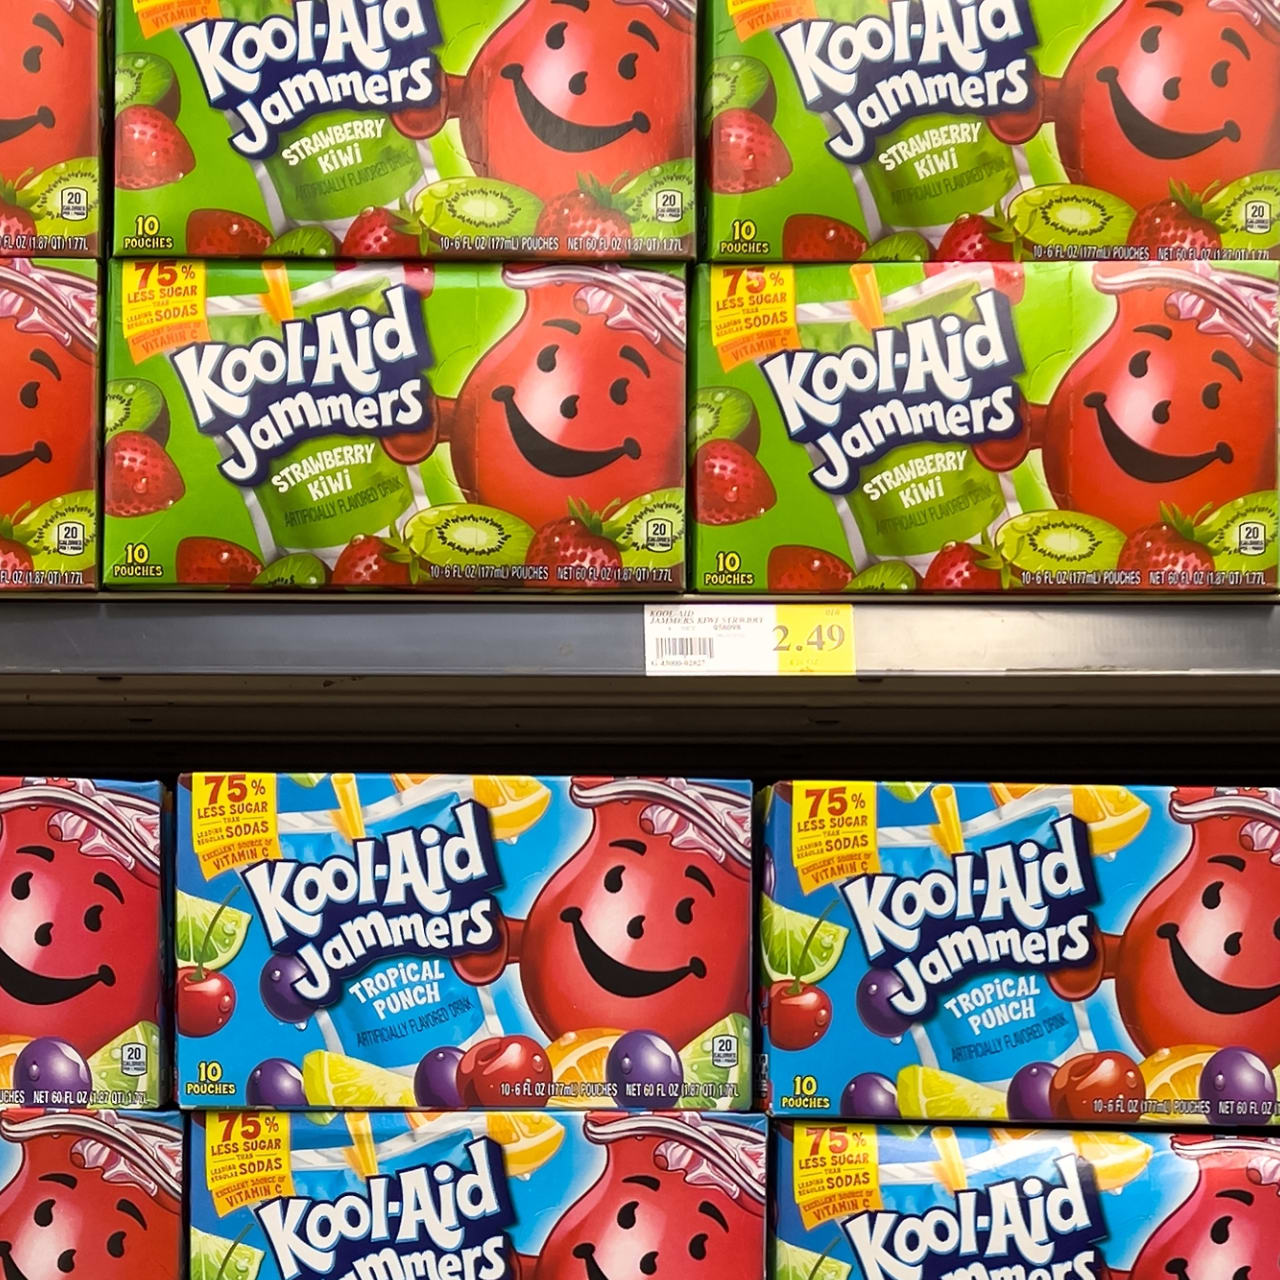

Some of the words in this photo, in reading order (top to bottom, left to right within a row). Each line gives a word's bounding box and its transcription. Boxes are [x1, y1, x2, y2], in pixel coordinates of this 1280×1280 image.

[234, 58, 432, 153] Jammers
[765, 291, 1009, 436] Kool-Aid
[814, 387, 1014, 488] Jammers
[61, 525, 77, 538] 20
[772, 624, 846, 652] 2.49
[844, 817, 1084, 957] Kool-Aid
[890, 915, 1089, 1014] Jammers
[259, 1139, 500, 1279] Kool-Aid
